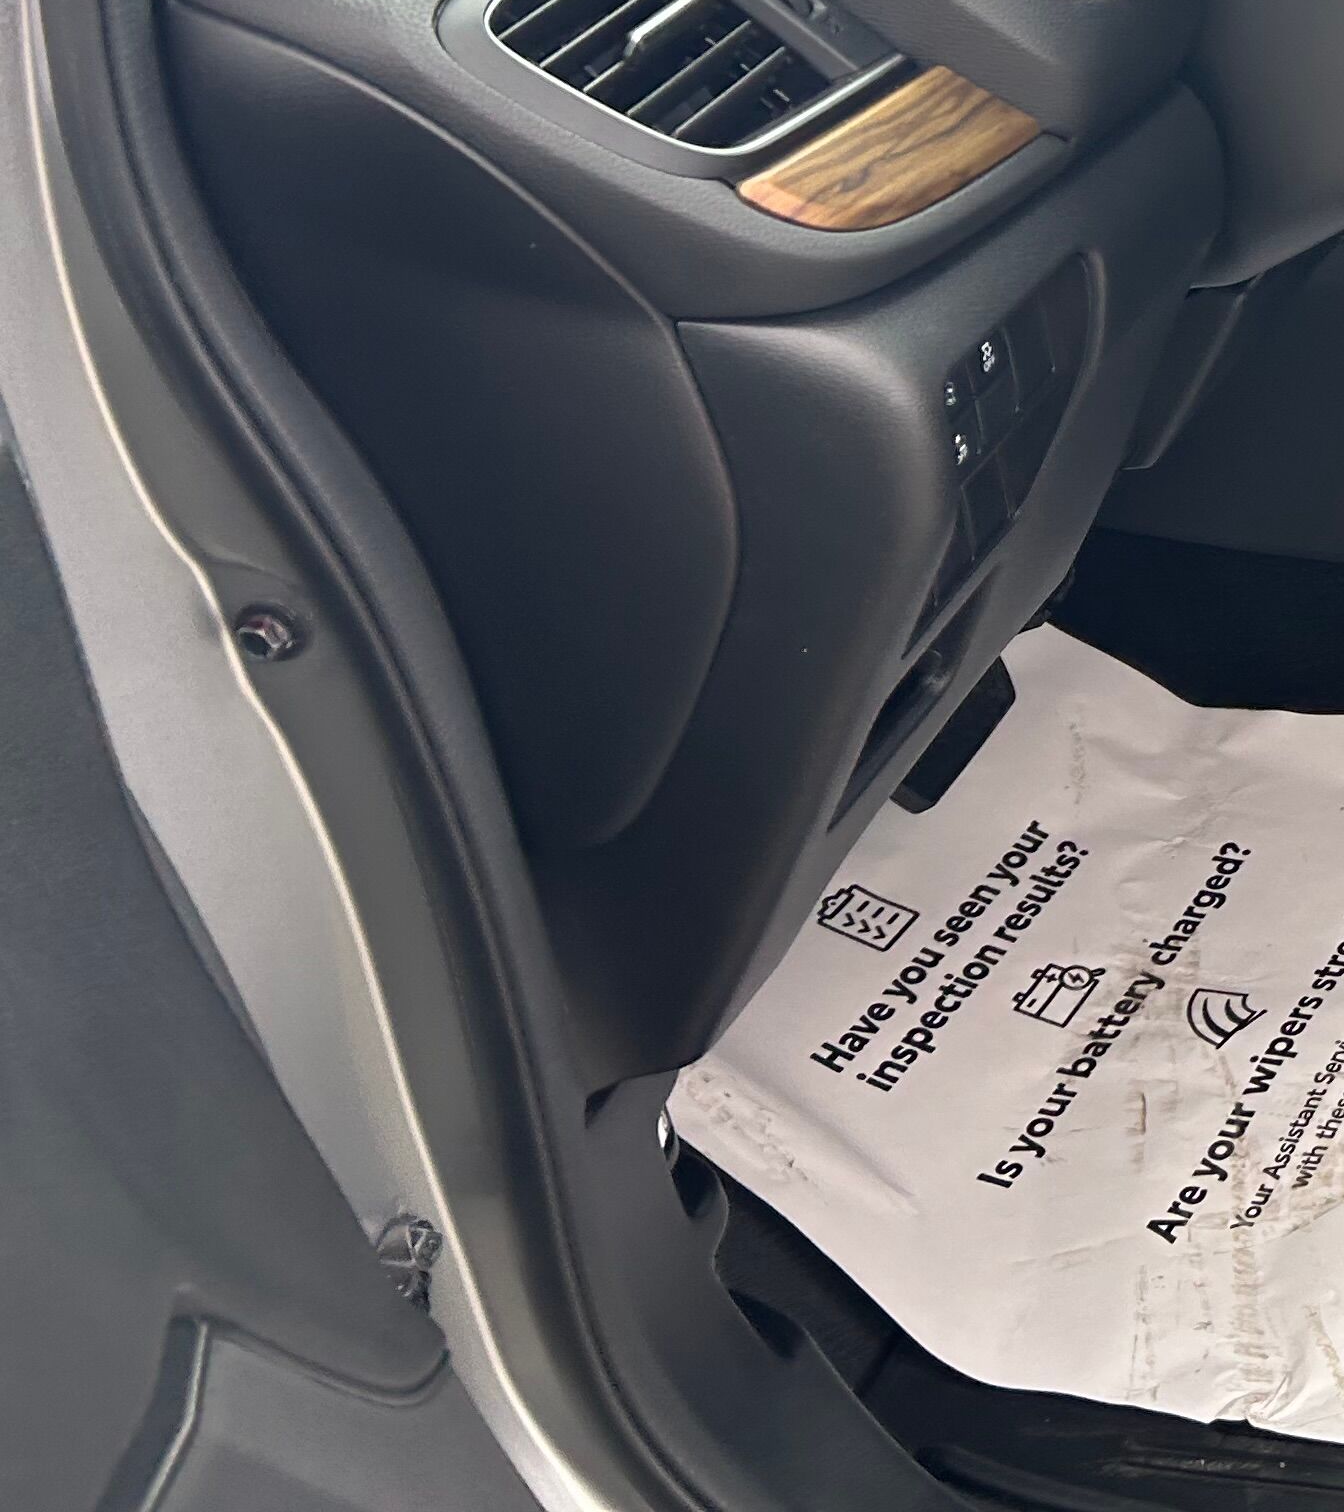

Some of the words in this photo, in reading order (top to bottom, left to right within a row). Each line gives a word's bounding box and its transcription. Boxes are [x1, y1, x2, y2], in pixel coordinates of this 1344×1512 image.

[810, 1003, 896, 1073] Have
[882, 947, 945, 1004] you
[934, 884, 1000, 947] seen
[987, 820, 1049, 887] your
[856, 944, 1007, 1092] inspection
[994, 840, 1089, 943] results?
[977, 1159, 1023, 1188] Is
[1010, 1083, 1077, 1158] your
[1056, 970, 1165, 1078] battery
[1149, 841, 1251, 965] charged?
[1146, 1185, 1208, 1244] Are
[1193, 1103, 1256, 1181] your
[1243, 995, 1323, 1095] wipers
[1229, 1183, 1273, 1229] Your
[1263, 1083, 1327, 1180] Assistant
[1291, 1144, 1322, 1189] with
